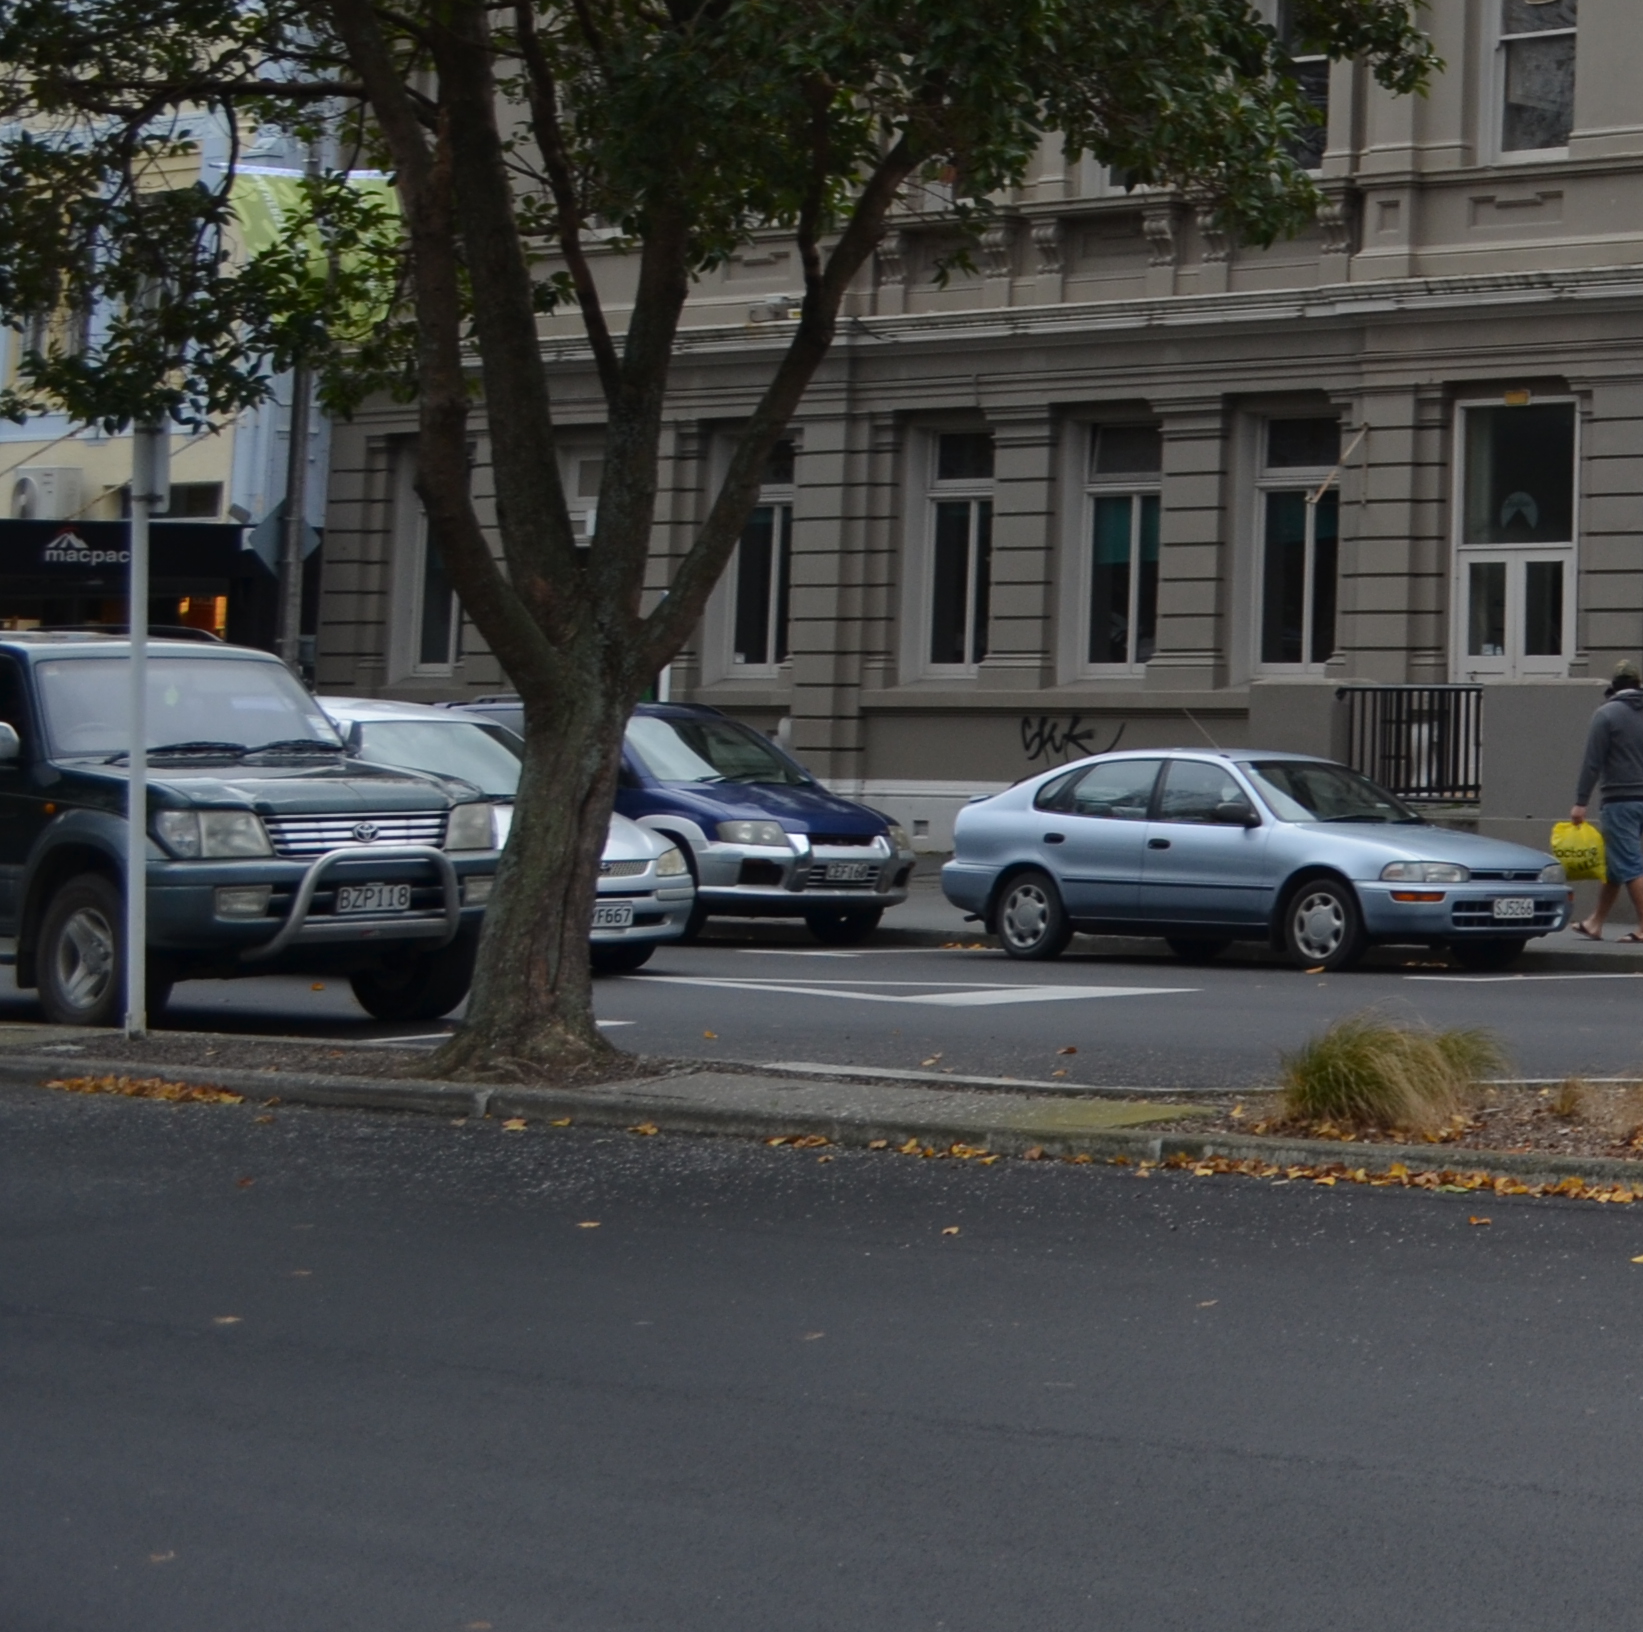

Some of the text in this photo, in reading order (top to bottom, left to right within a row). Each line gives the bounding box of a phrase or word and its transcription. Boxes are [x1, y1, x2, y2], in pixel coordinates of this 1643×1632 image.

[44, 549, 130, 566] macpac
[340, 886, 408, 909] BZP118
[594, 908, 632, 924] F667
[1496, 900, 1533, 916] SJ5266
